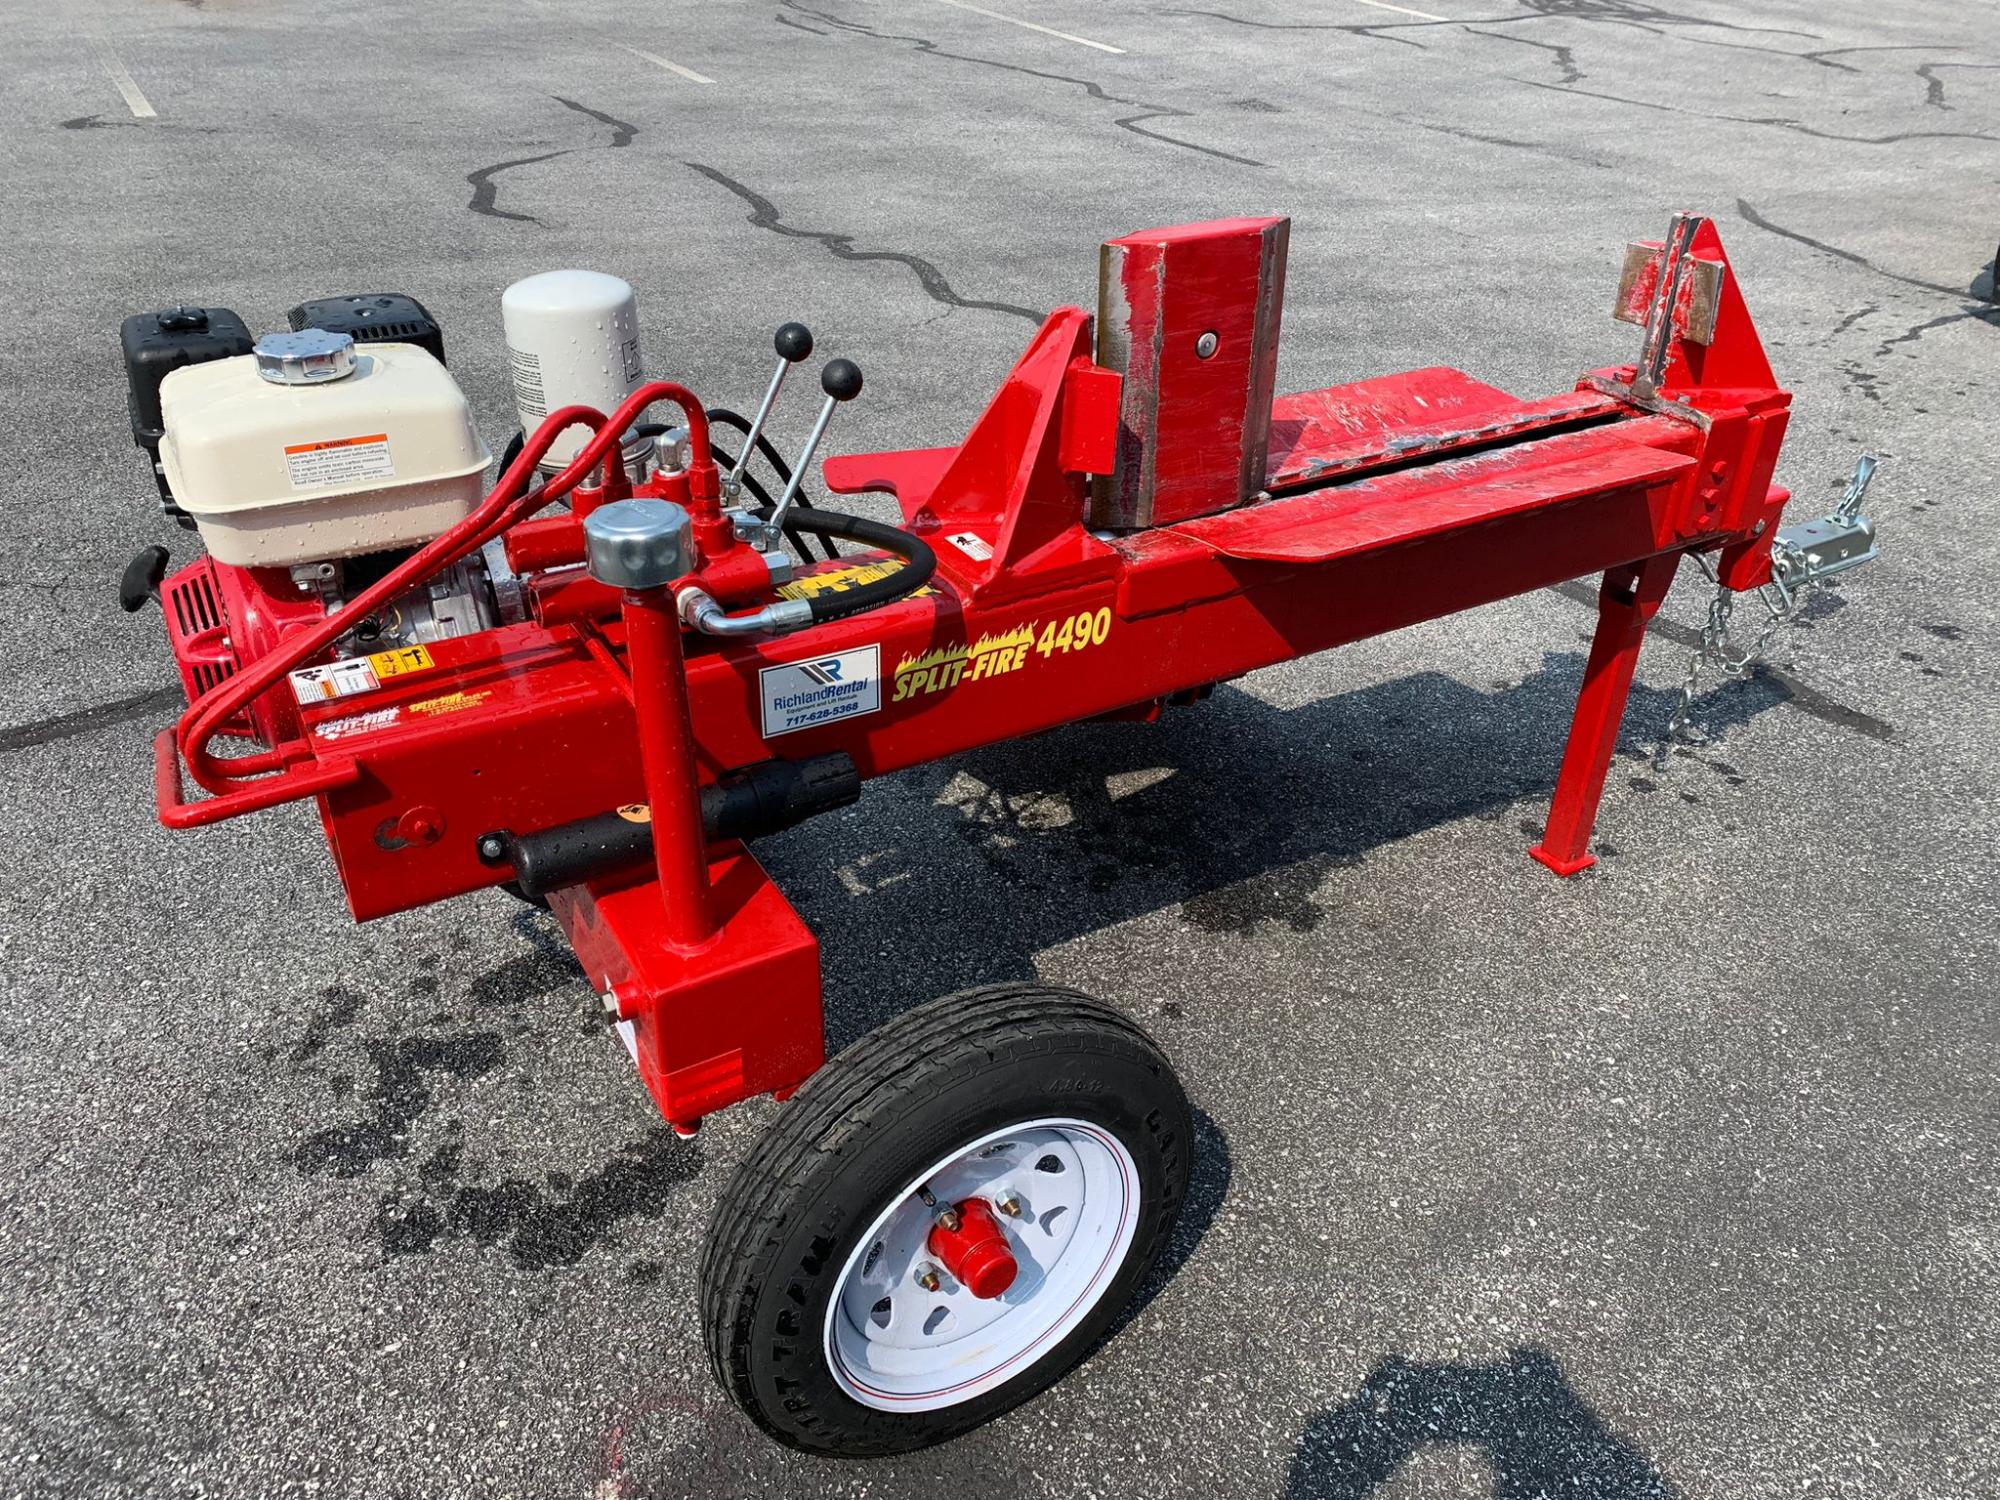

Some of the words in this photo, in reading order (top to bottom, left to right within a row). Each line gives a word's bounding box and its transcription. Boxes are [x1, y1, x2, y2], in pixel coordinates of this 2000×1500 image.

[325, 440, 352, 448] WARNING
[892, 643, 1031, 702] SPLIT-FIRE
[1036, 606, 1112, 659] 4490
[774, 677, 868, 711] RichlandRental
[786, 702, 859, 727] 717-628-5368
